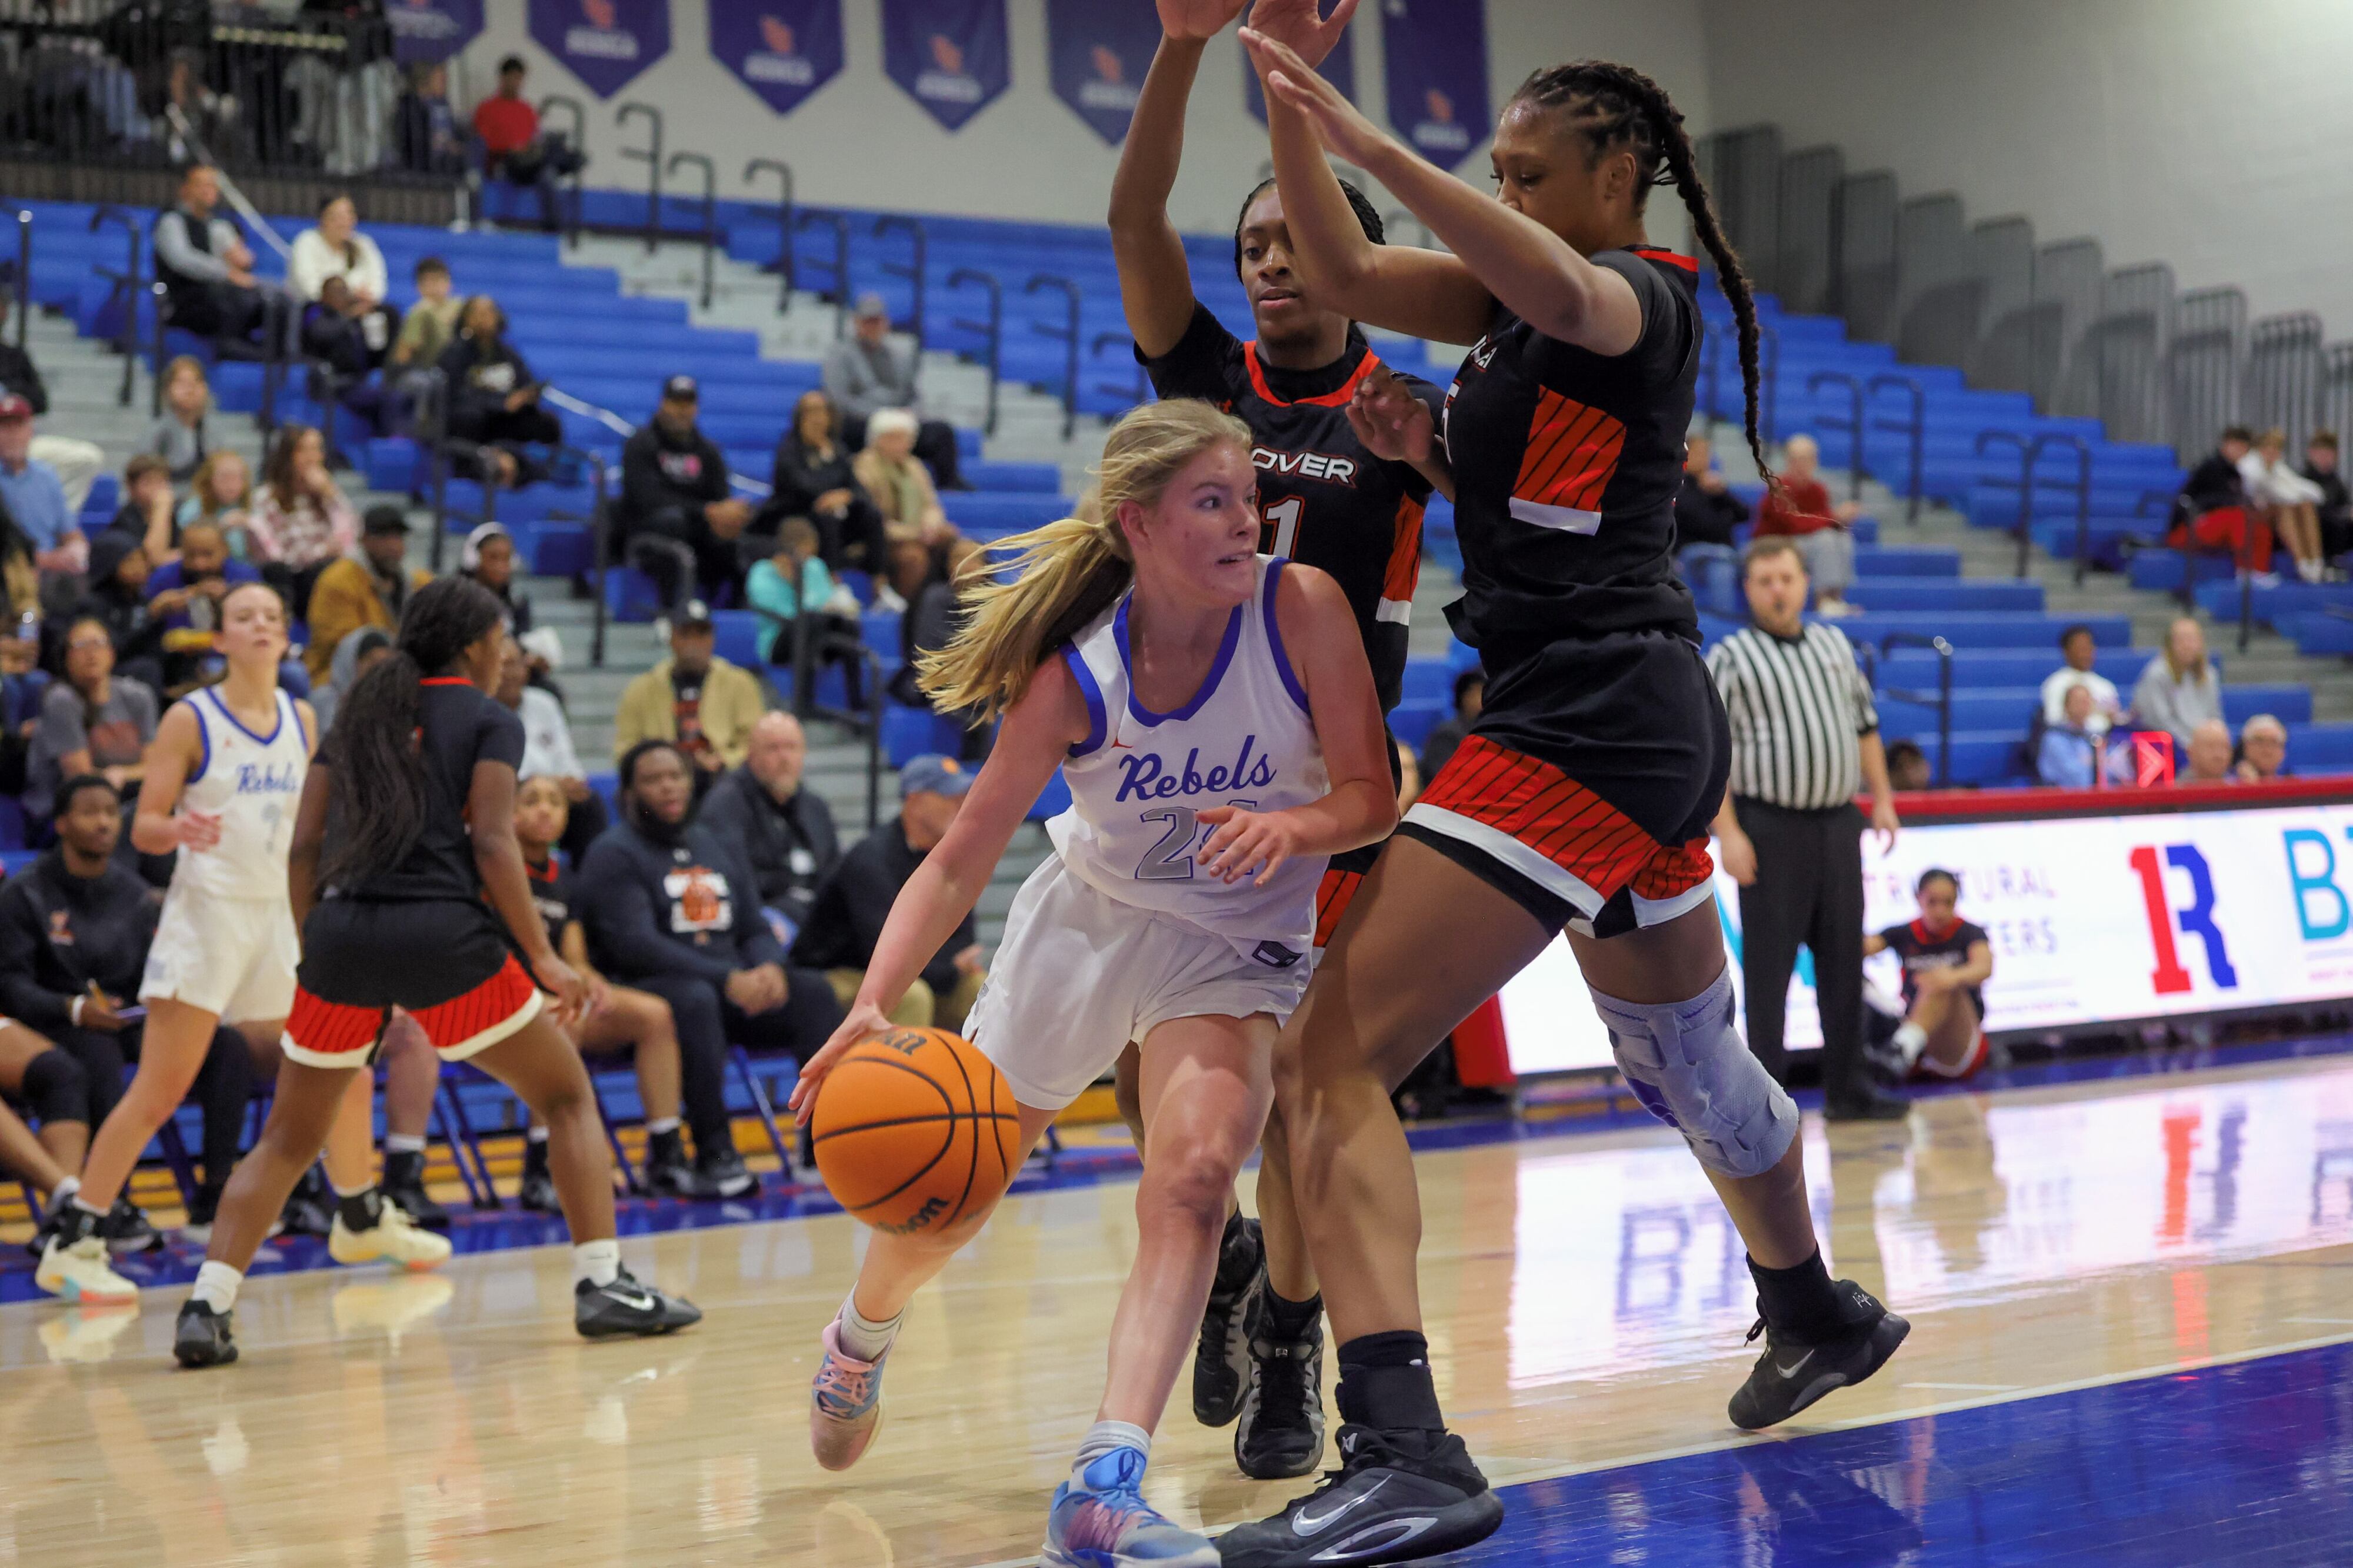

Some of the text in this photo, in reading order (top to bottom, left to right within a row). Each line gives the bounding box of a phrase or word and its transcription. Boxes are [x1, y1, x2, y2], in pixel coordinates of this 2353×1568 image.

[1251, 446, 1355, 485] OVER
[1262, 496, 1304, 559] 1
[1115, 735, 1277, 802] Rebels
